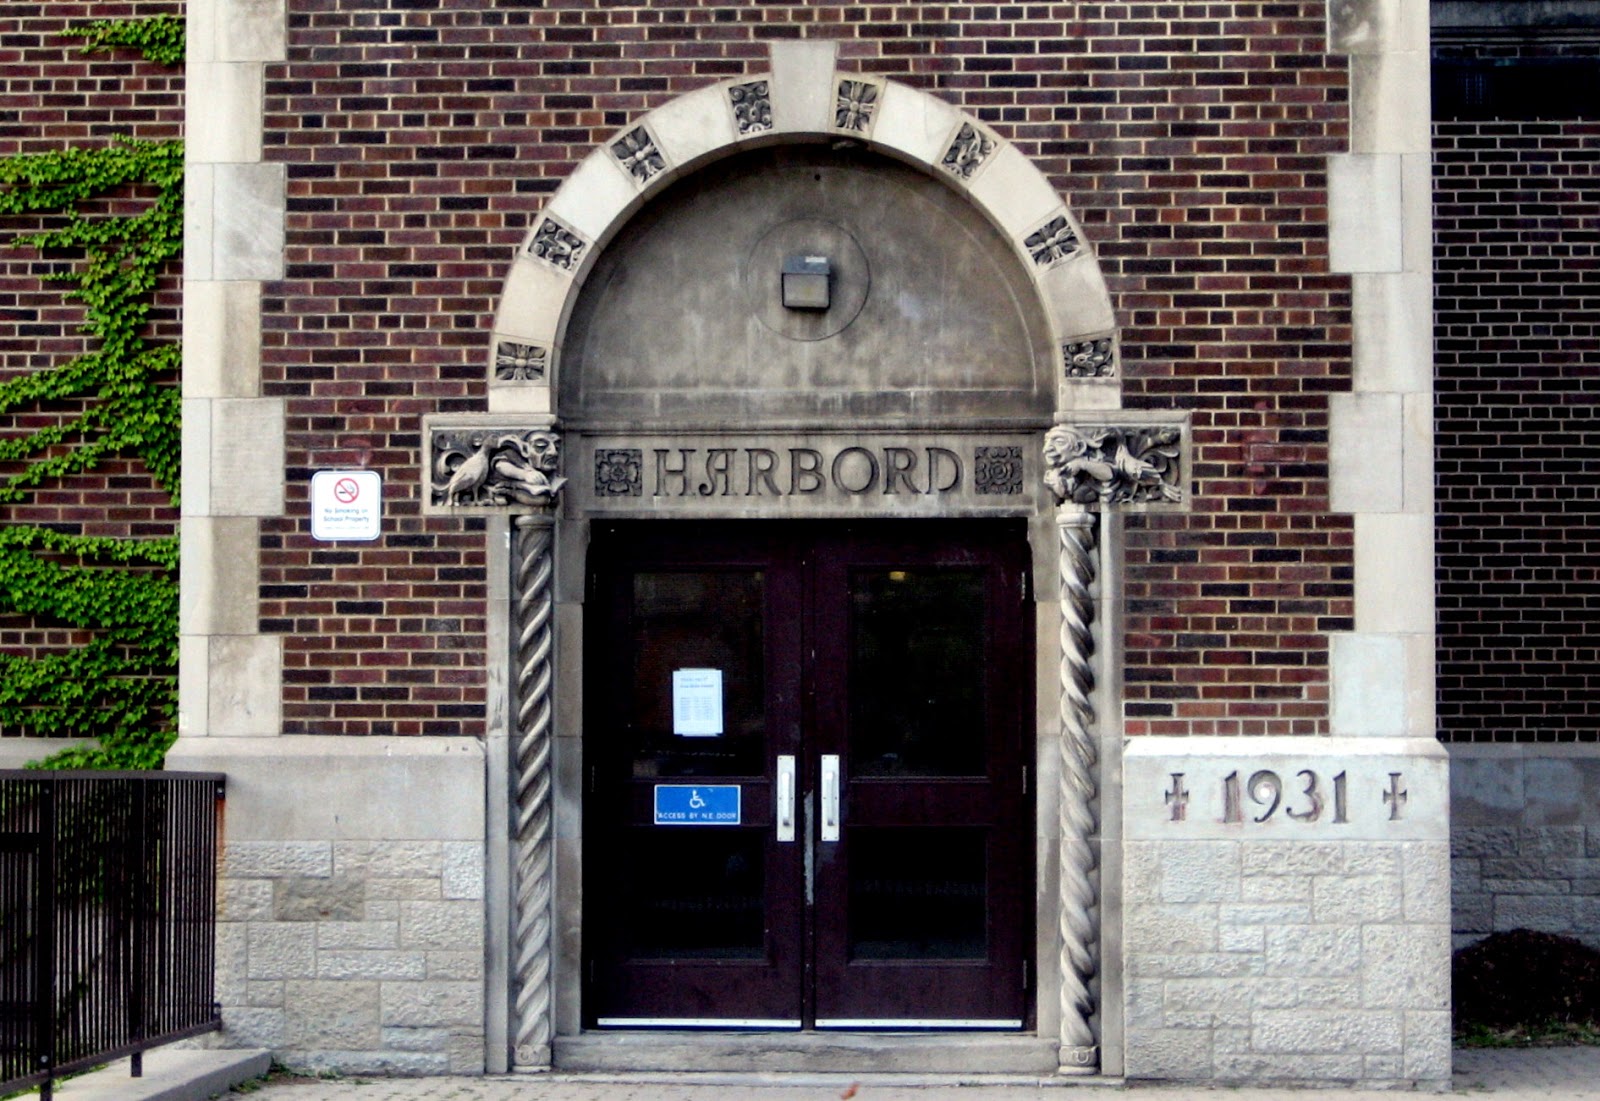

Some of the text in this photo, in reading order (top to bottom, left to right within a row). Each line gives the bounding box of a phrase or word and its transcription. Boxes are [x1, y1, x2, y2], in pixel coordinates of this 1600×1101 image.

[653, 446, 965, 497] HARBORD
[335, 507, 359, 515] Smoking
[1221, 769, 1349, 824] 1931
[658, 812, 686, 820] ACCESS
[689, 812, 698, 820] BY
[716, 812, 737, 820] DOOR
